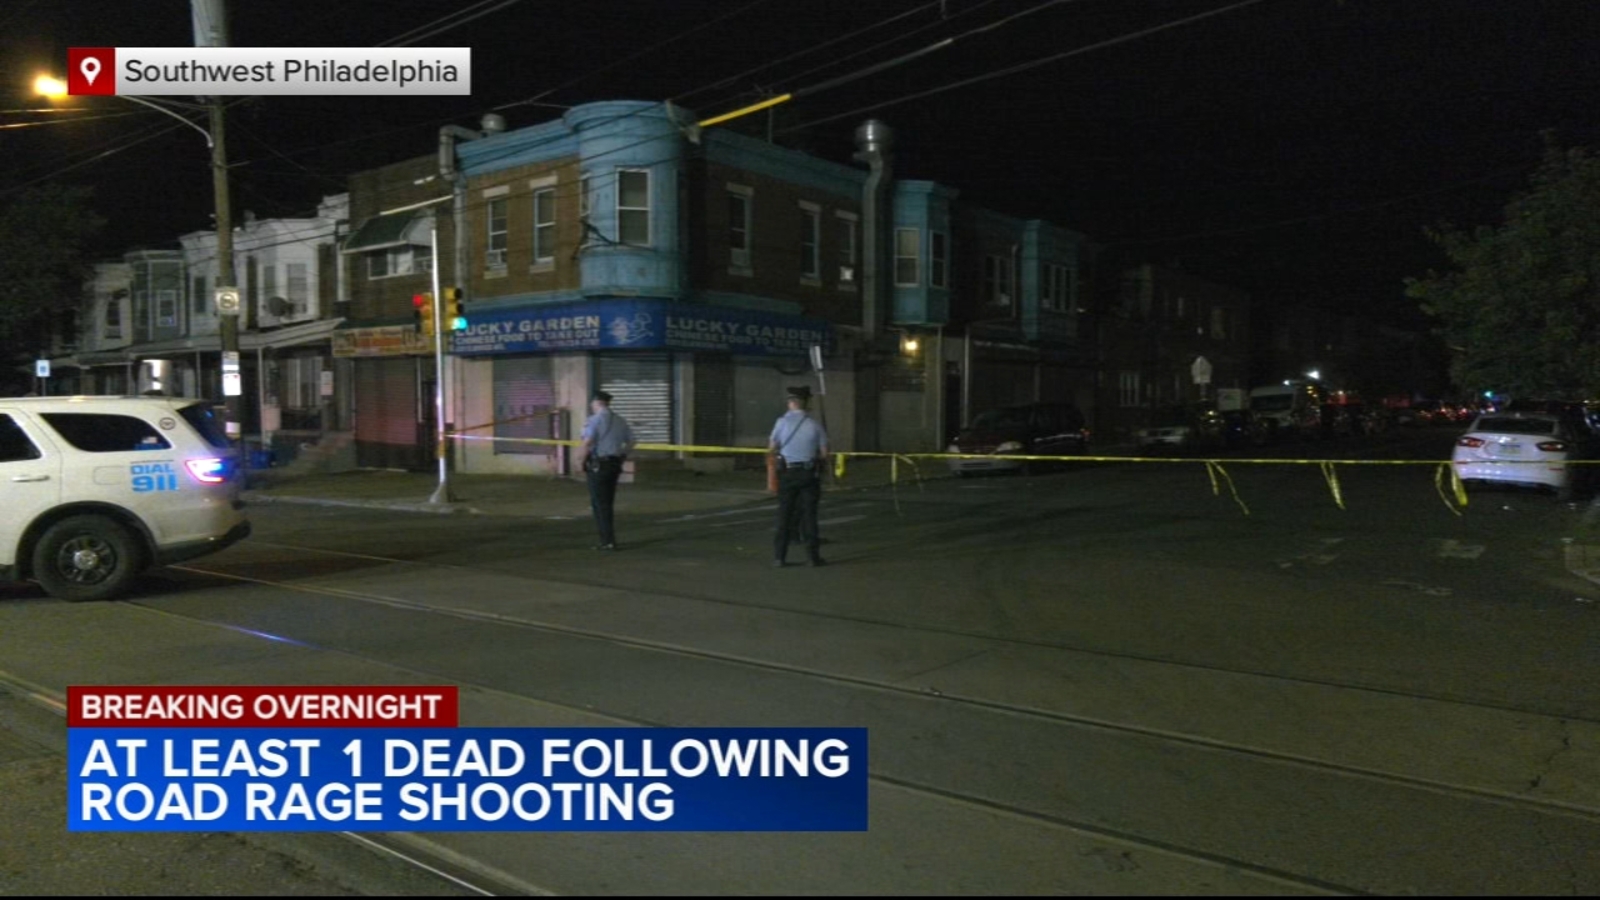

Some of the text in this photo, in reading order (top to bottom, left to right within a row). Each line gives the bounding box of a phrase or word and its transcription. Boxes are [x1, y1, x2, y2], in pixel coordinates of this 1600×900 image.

[456, 316, 600, 336] LUCKY GARDEN
[528, 331, 543, 341] TO
[574, 328, 600, 339] OUT
[666, 317, 823, 341] LUCKY GARDEN
[130, 463, 174, 475] DIAL
[132, 474, 177, 492] 911
